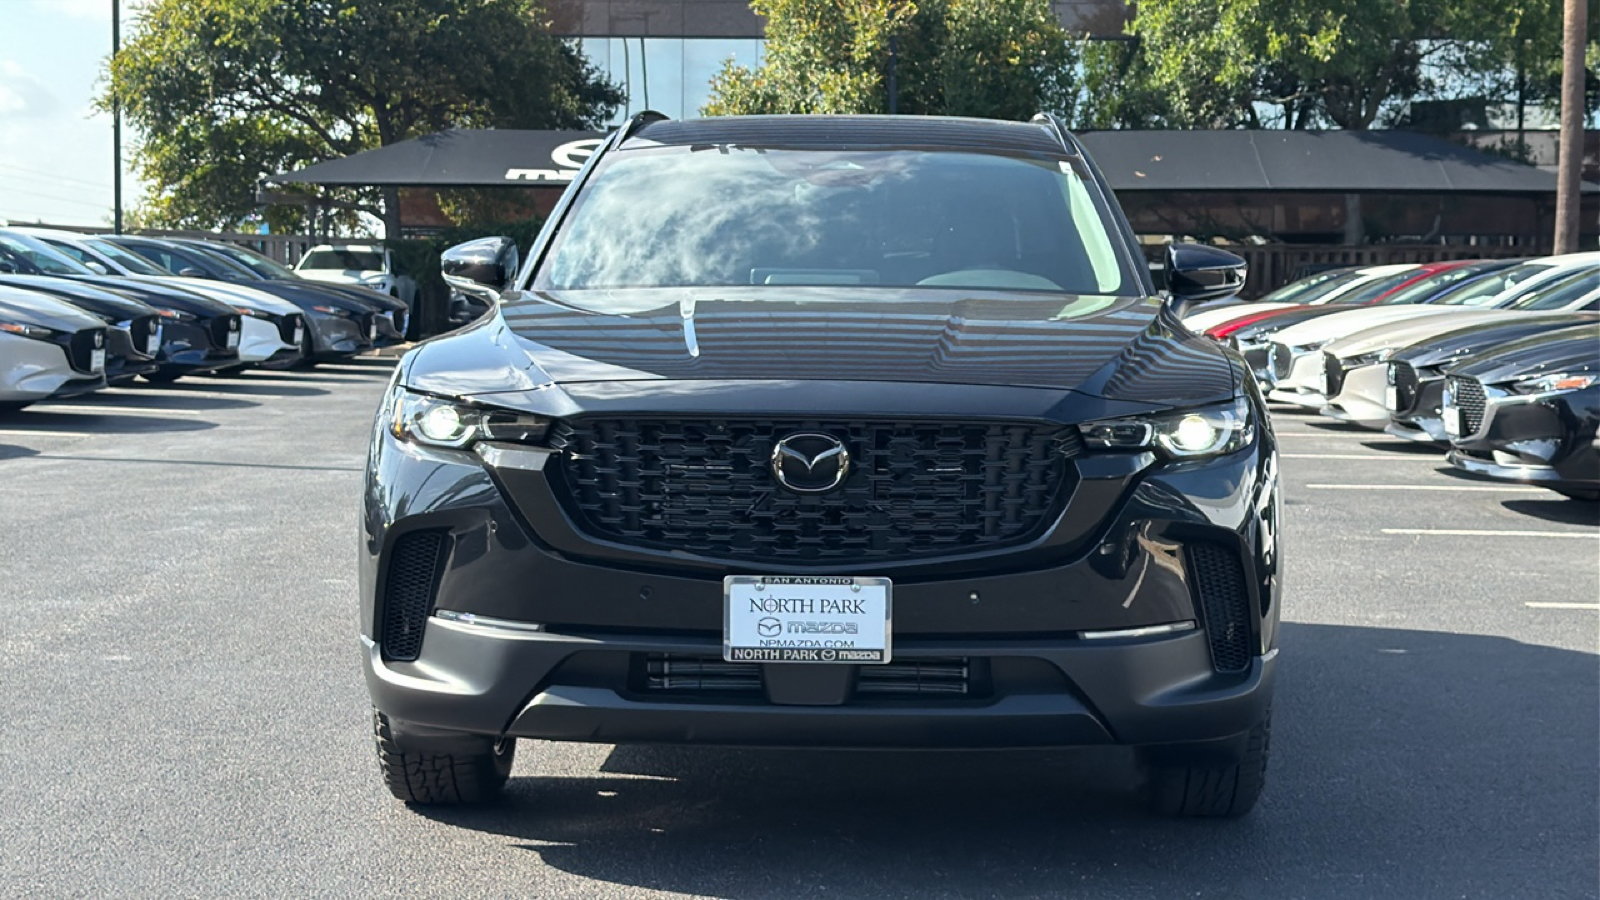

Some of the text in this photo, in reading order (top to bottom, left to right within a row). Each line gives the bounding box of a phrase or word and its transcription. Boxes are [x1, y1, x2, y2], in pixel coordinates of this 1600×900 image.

[749, 595, 866, 614] NORTH PARK
[787, 621, 858, 634] mazda
[760, 639, 855, 648] NPMAZDACOM
[734, 649, 881, 660] NORTH PARK mazda
